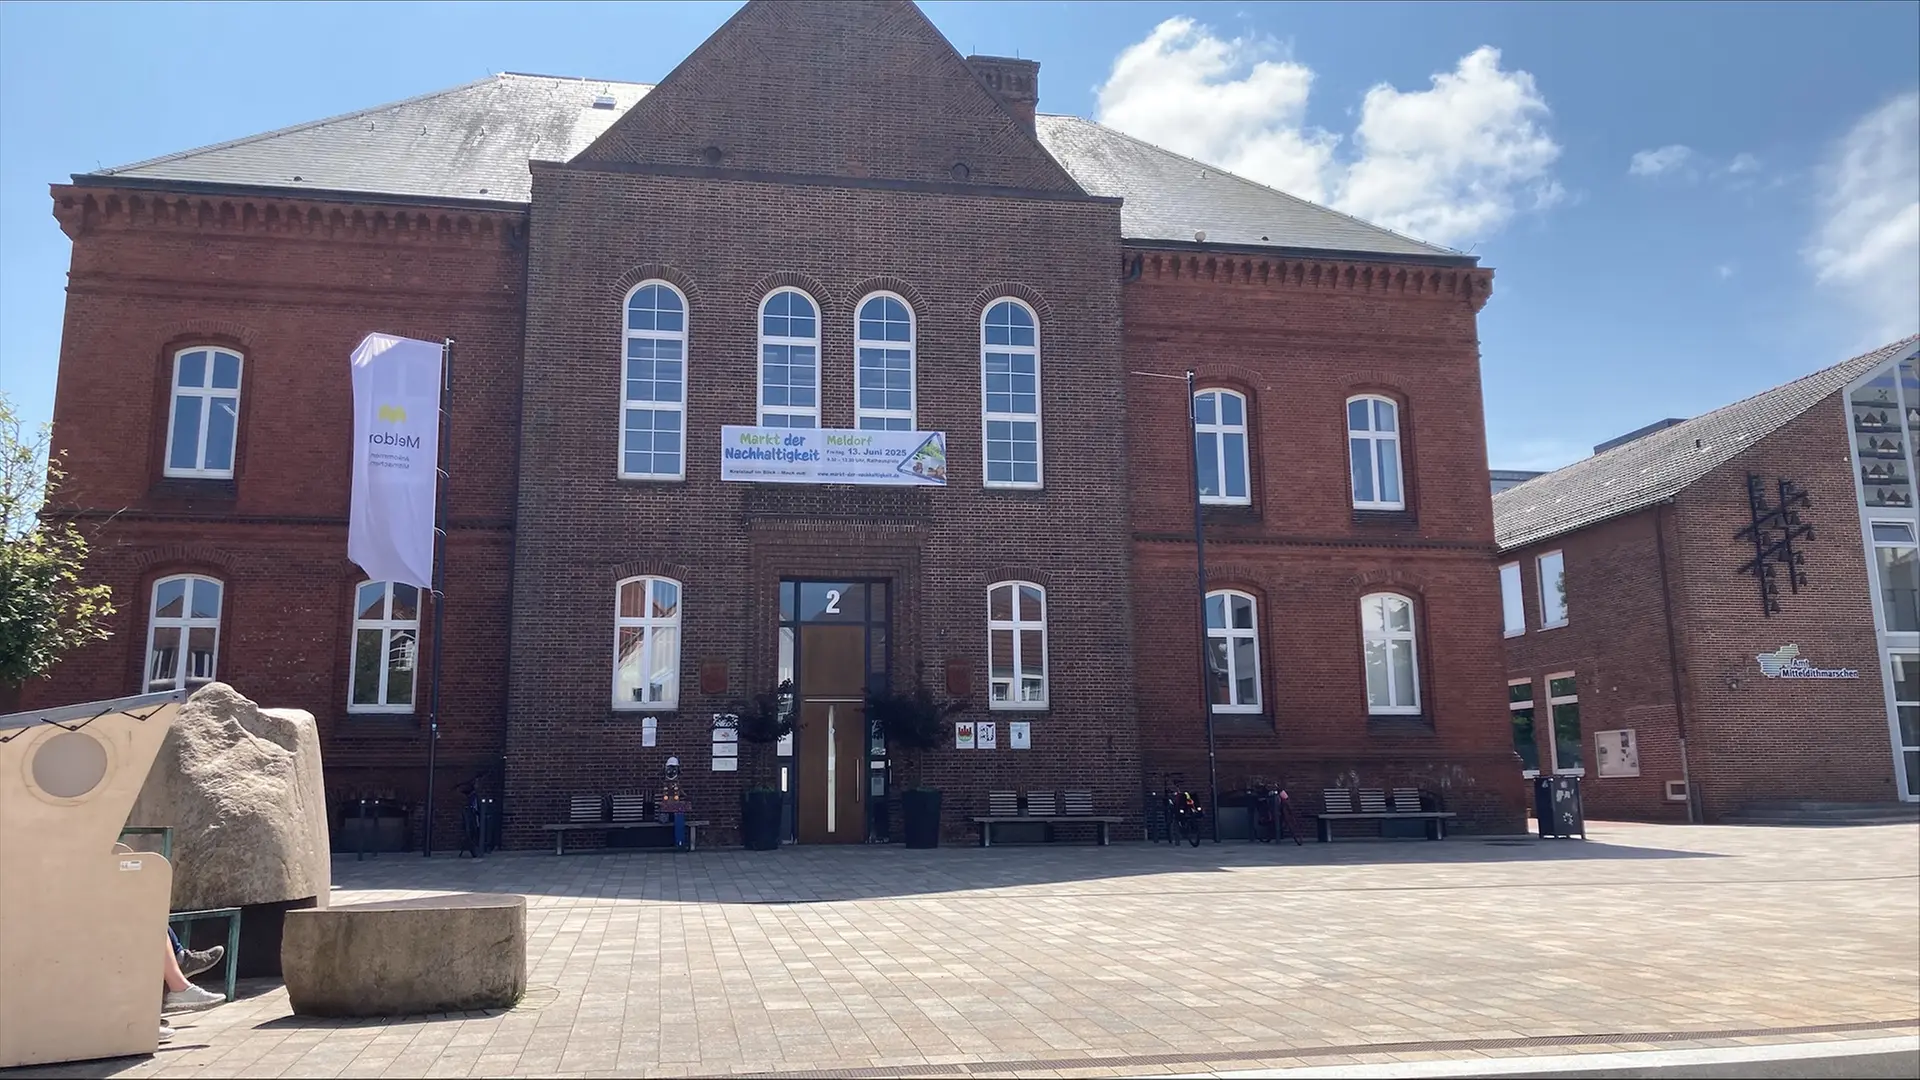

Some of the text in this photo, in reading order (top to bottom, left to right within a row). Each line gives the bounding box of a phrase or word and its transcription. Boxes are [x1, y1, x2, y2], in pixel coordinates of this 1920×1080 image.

[740, 433, 806, 446] Markt der
[827, 435, 873, 446] Meldorf
[725, 447, 820, 463] Nachhaltigkeit
[847, 447, 861, 456] 13.
[863, 447, 882, 456] Juni
[885, 448, 907, 457] 2025
[826, 589, 840, 614] 2
[1792, 659, 1809, 667] Amt
[1782, 668, 1858, 678] Mitteldithmarschen
